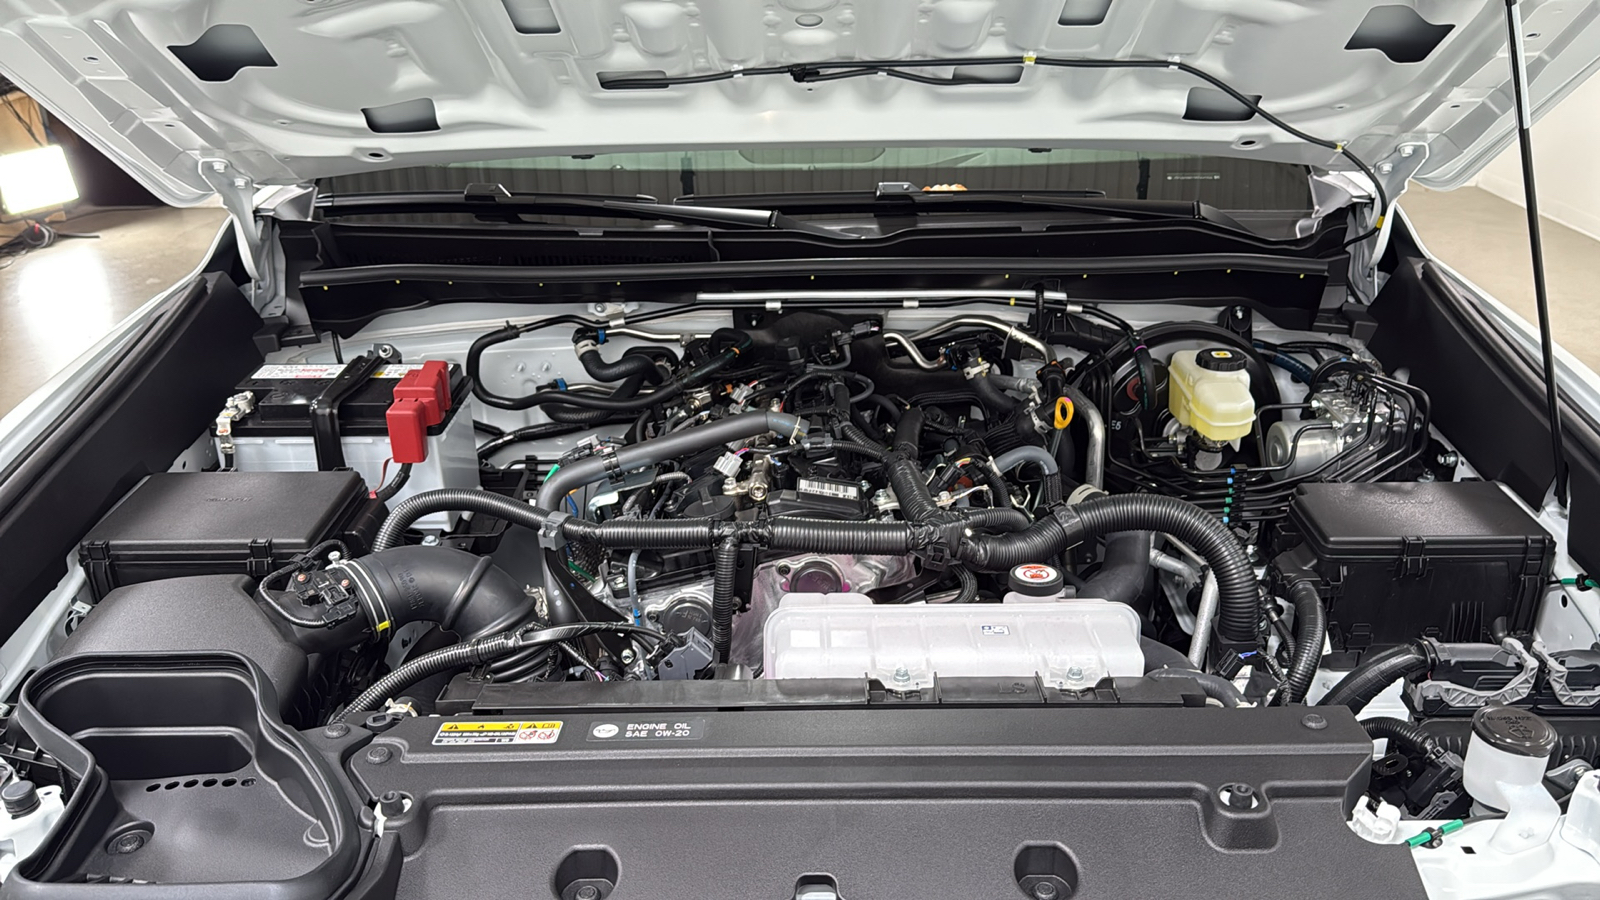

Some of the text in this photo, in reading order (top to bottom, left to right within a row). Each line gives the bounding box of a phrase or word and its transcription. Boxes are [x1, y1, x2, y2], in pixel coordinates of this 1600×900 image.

[626, 722, 692, 731] ENGINE OIL
[624, 730, 648, 738] SAE
